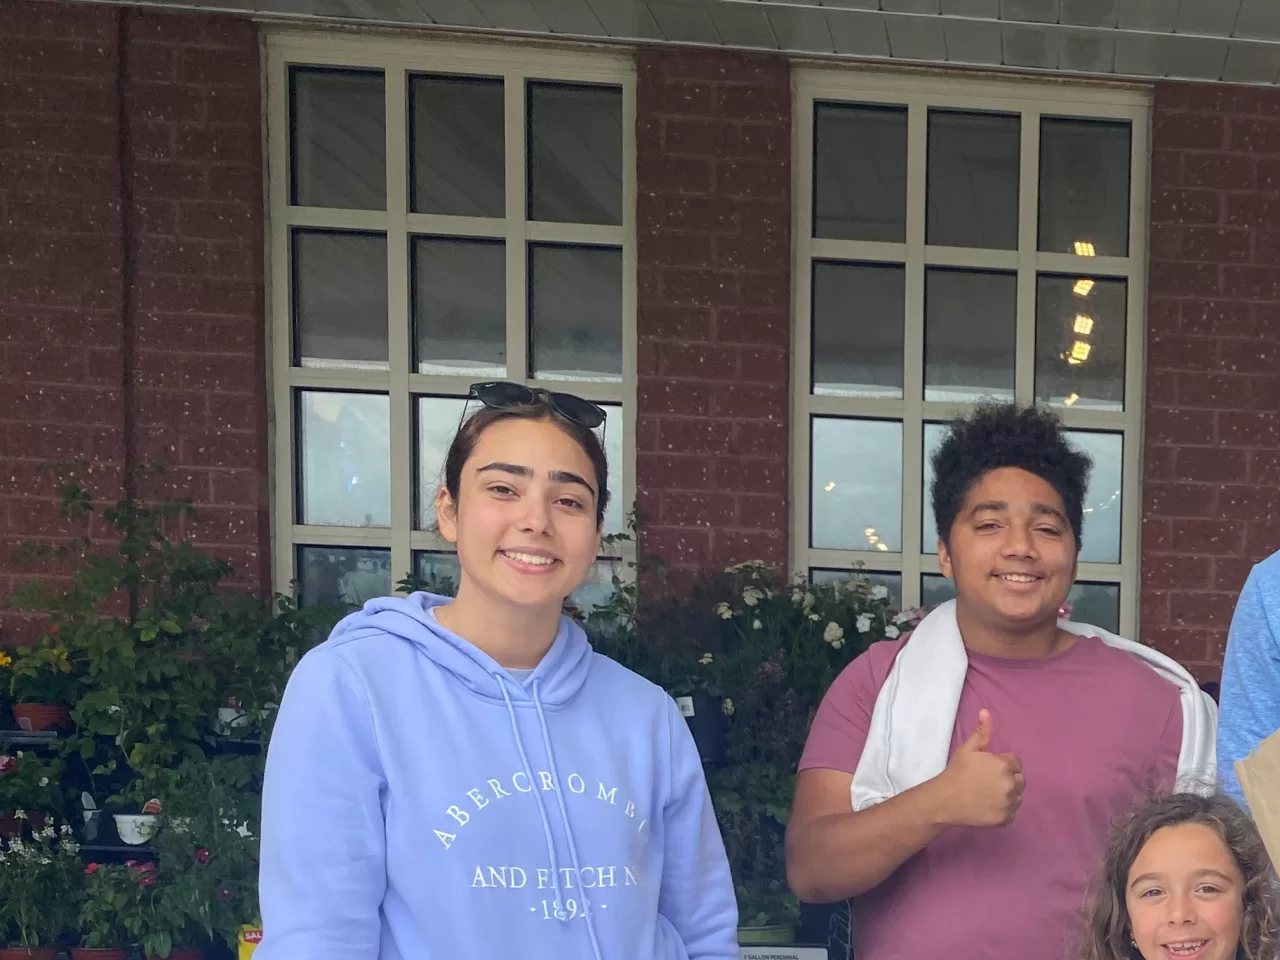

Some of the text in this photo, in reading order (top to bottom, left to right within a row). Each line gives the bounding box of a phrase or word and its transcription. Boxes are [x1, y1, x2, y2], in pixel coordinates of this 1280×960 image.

[433, 771, 648, 850] ABERCROMBI
[471, 866, 617, 889] AND FTCH
[245, 931, 261, 940] SAL
